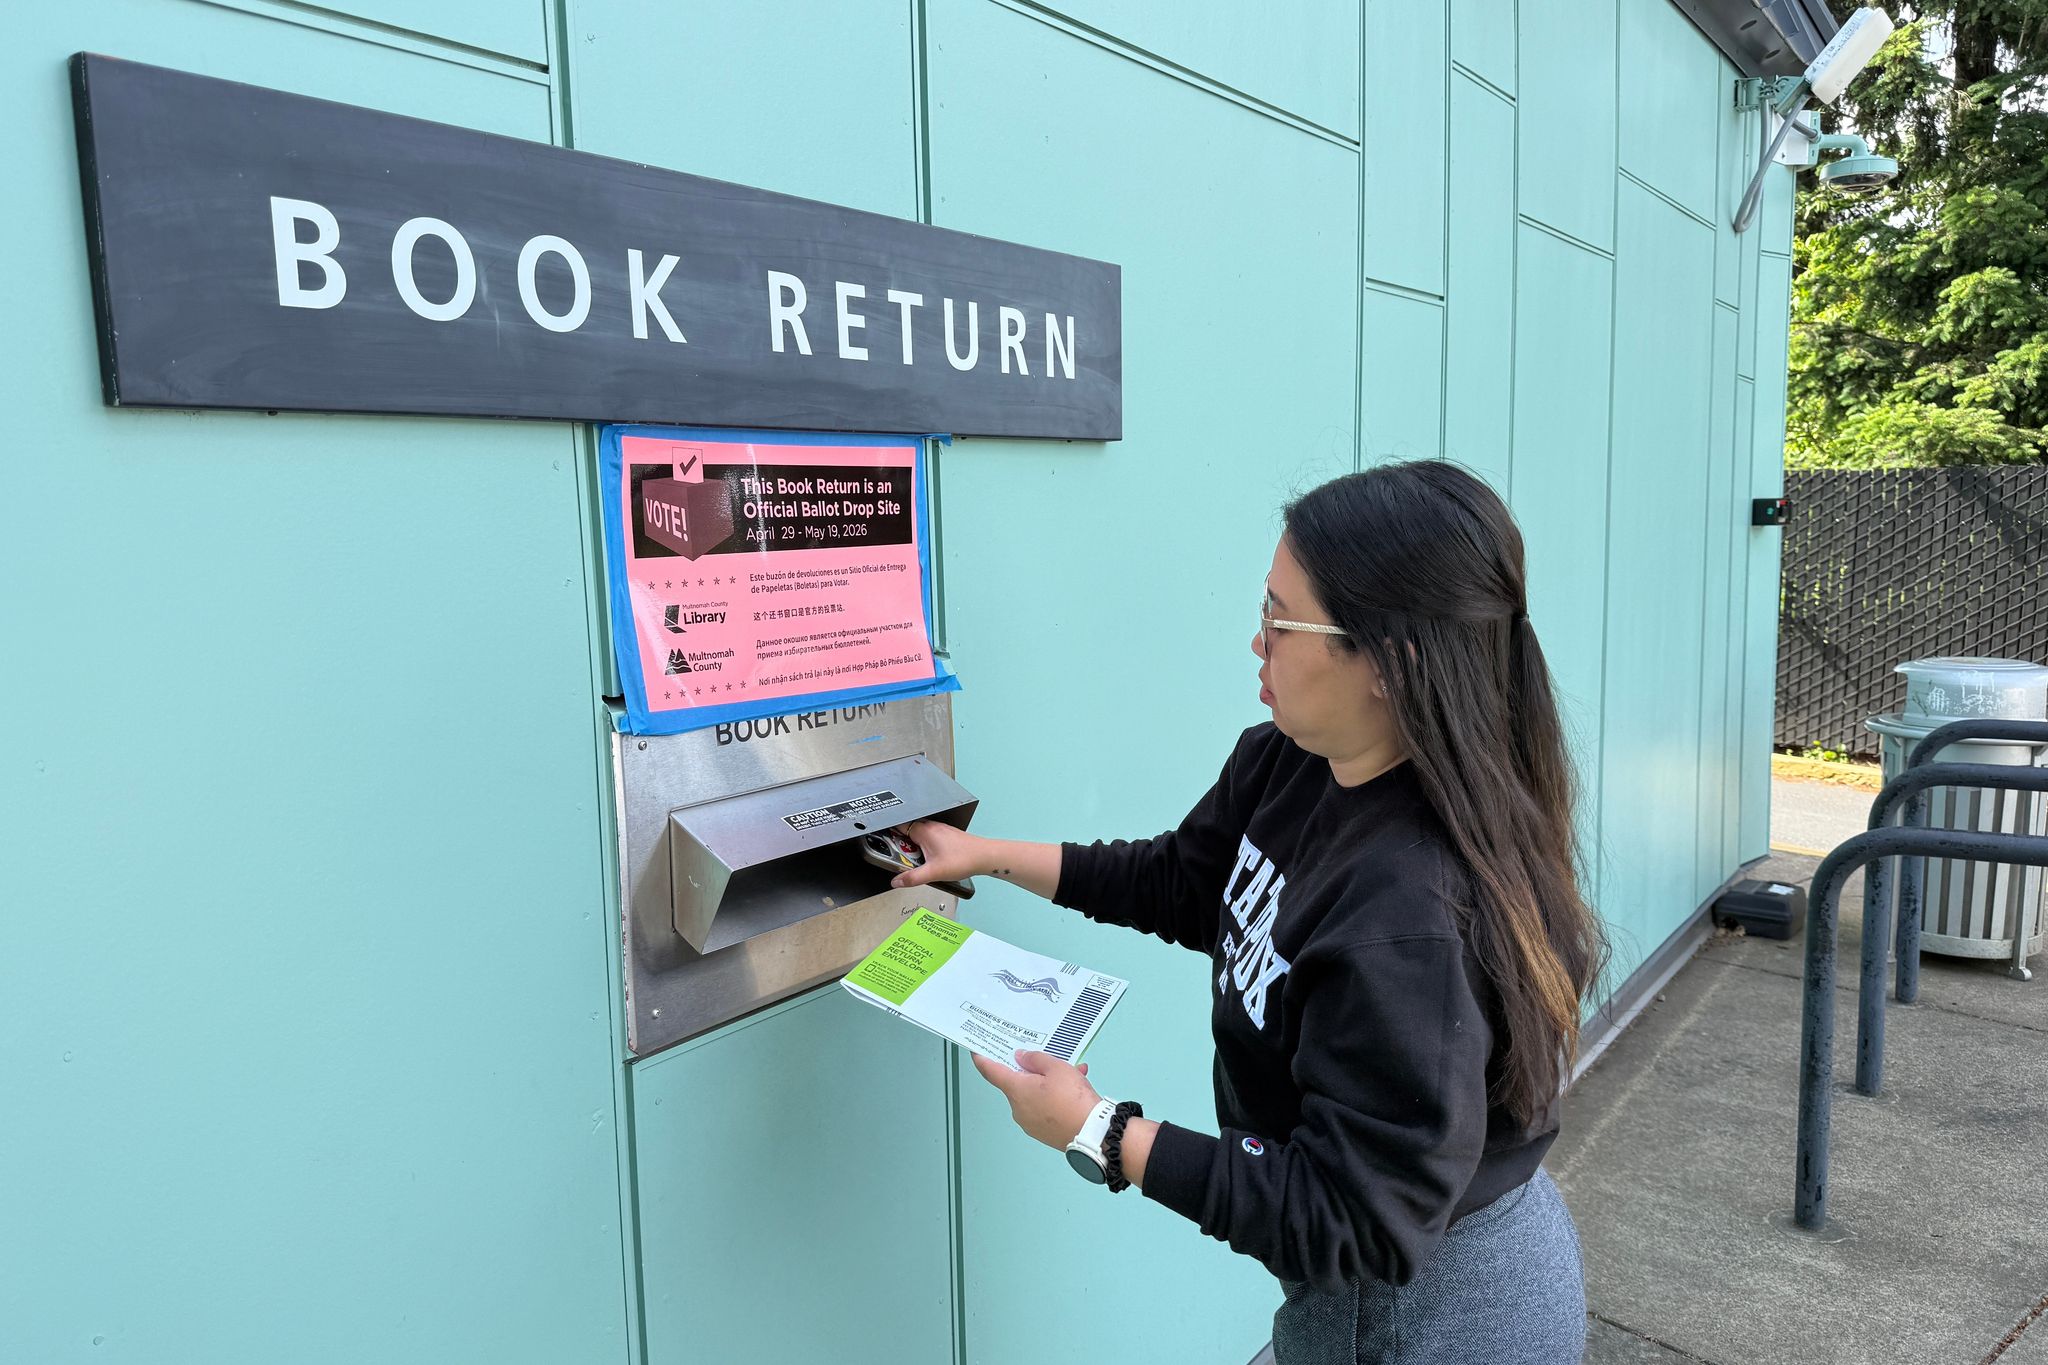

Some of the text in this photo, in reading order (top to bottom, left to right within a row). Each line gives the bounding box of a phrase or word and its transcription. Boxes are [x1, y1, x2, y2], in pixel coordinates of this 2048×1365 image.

[271, 195, 1077, 381] BOOK RETURN
[740, 478, 892, 495] This Book Return is an
[743, 499, 901, 519] Official Ballot Drop Site
[645, 498, 689, 542] VOTE!
[746, 526, 775, 543] April
[781, 525, 795, 540] 29
[805, 525, 825, 540] May
[827, 524, 841, 539] 19,
[842, 523, 868, 537] 2026
[750, 573, 764, 581] Este
[766, 570, 786, 580] buzón
[788, 571, 795, 579] de
[796, 569, 833, 578] devoluciones
[849, 565, 861, 574] Sitio
[880, 564, 886, 572] de
[887, 563, 907, 572] Entrega
[751, 579, 850, 594] de Papeletas (Boletas) para Votar.
[683, 611, 726, 624] Library
[756, 638, 782, 649] Данное
[783, 634, 808, 644] окошко
[809, 631, 837, 641] является
[838, 626, 878, 638] официальным
[688, 648, 734, 661] Multnomah
[757, 650, 783, 660] приема
[784, 643, 833, 656] избирательных
[693, 661, 722, 671] County
[715, 715, 791, 747] BOOK
[848, 795, 881, 808] NOTICE
[789, 808, 830, 823] CAUTION
[916, 919, 942, 938] Votes
[921, 918, 958, 938] Multnomah
[887, 946, 923, 966] RETURN
[892, 941, 927, 960] BALLOT
[897, 936, 934, 959] OFFICIAL
[881, 950, 928, 976] ENVELOPE
[969, 1005, 1001, 1023] BUSINESS
[1001, 1021, 1023, 1033] REPLY
[1023, 1030, 1039, 1038] MAIL
